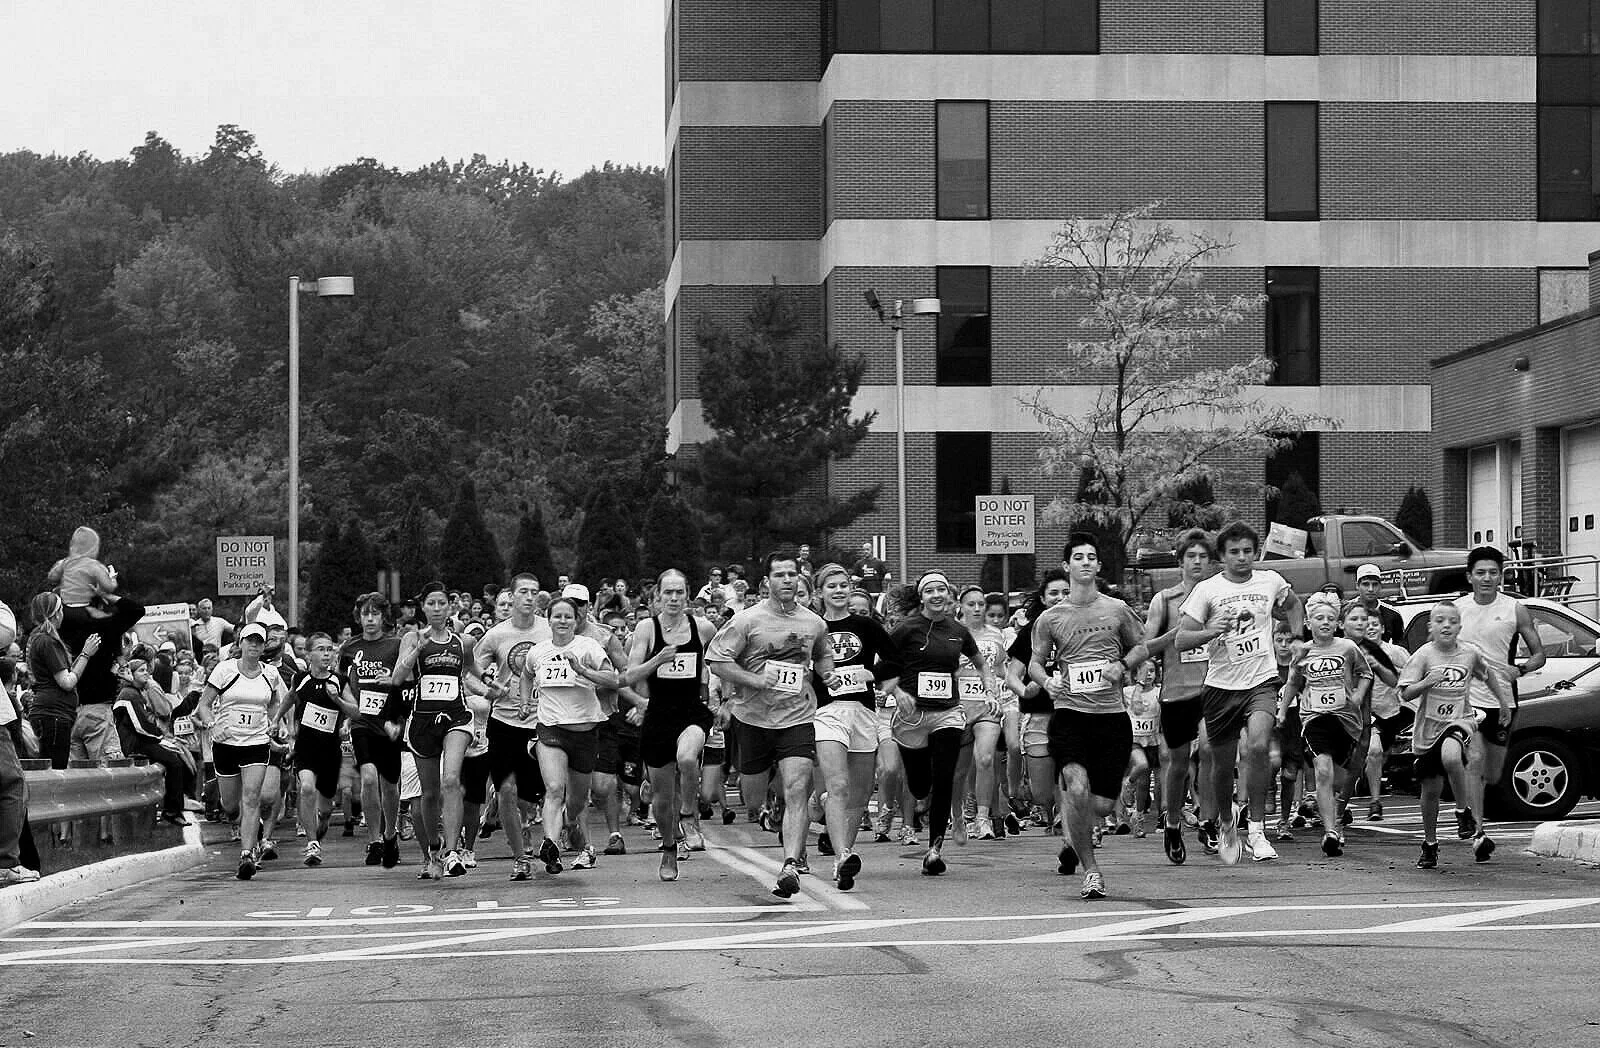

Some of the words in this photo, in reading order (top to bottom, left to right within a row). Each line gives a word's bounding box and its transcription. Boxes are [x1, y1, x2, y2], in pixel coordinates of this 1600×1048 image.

[980, 501, 998, 511] DO
[1004, 500, 1031, 511] NOT
[984, 515, 1026, 525] ENTER
[987, 530, 1023, 539] Physician
[221, 542, 240, 553] DO
[244, 541, 270, 552] NOT
[981, 540, 1009, 549] Parking
[1012, 539, 1029, 548] Only
[225, 556, 266, 567] ENTER
[228, 572, 264, 581] Physician
[223, 581, 251, 590] Parking
[1236, 637, 1260, 656] 307
[361, 660, 383, 671] Race
[669, 659, 685, 672] 35
[546, 667, 568, 680] 274
[1076, 668, 1103, 684] 407
[428, 681, 451, 693] 277
[925, 679, 947, 692] 399
[964, 683, 985, 695] 259
[365, 697, 385, 709] 252
[1320, 693, 1336, 705] 65
[1437, 703, 1456, 716] 68
[238, 713, 252, 726] 31
[314, 711, 329, 726] 78
[1135, 720, 1154, 731] 361
